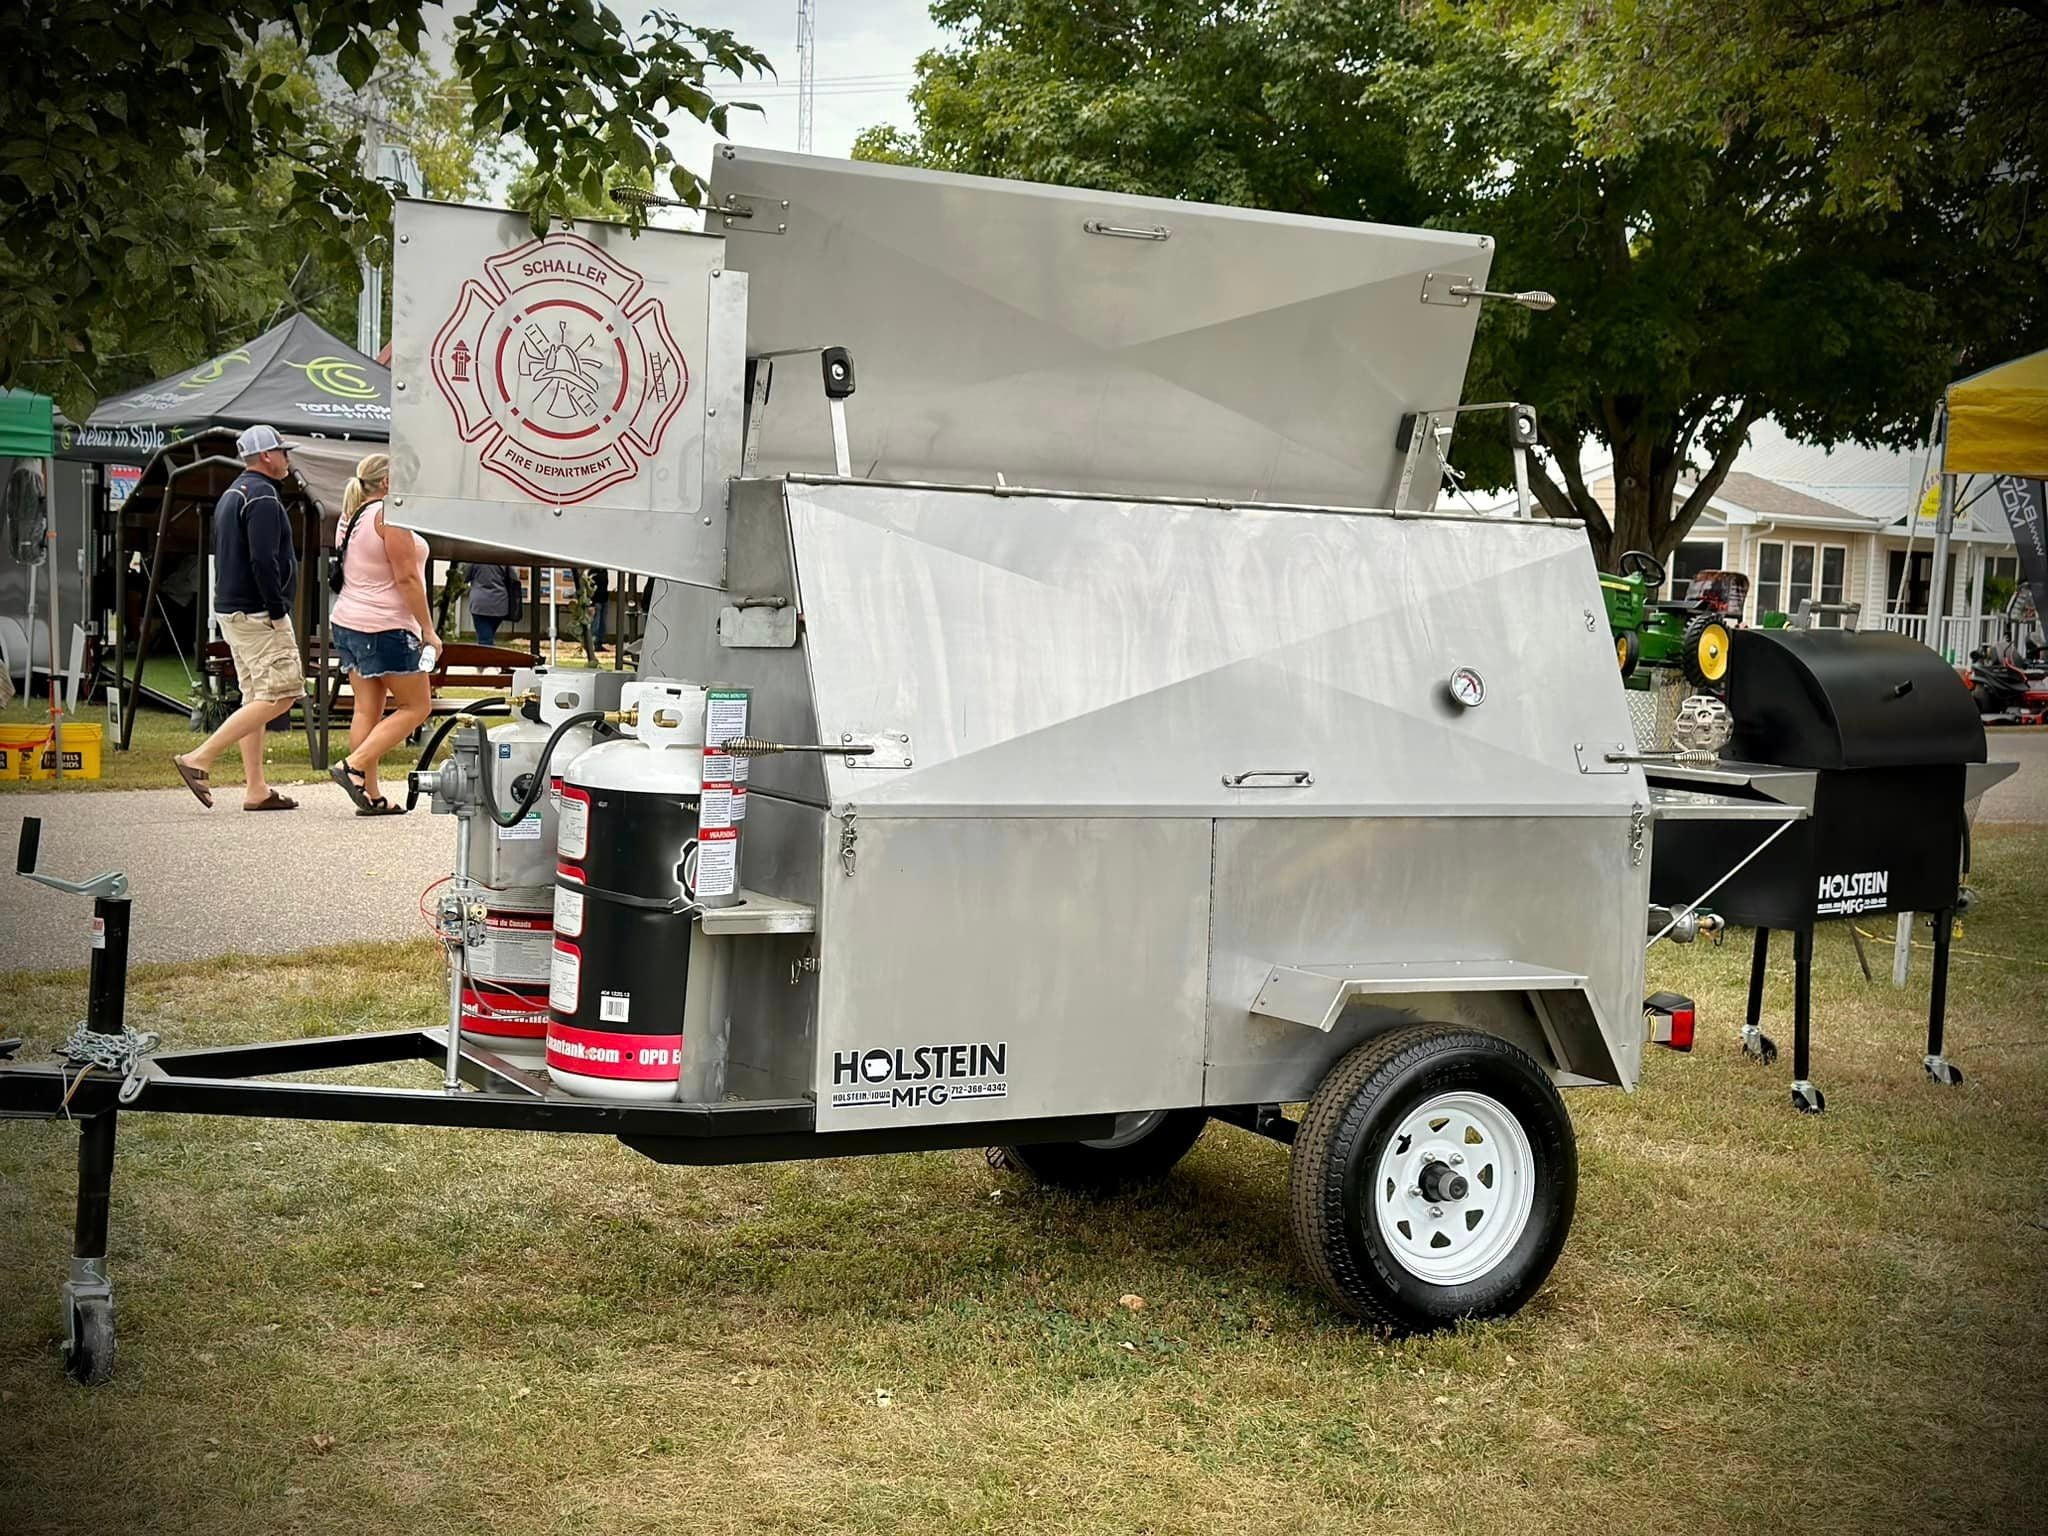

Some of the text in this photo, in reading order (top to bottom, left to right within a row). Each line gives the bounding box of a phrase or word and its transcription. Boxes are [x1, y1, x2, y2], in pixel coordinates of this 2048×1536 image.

[522, 259, 608, 286] SCHALLER
[76, 422, 168, 454] Relax in Style
[505, 448, 613, 478] FIRE DEPARTMENT
[709, 830, 736, 839] WARNING
[1818, 871, 1888, 899] HOLSTEIN
[1840, 898, 1864, 914] MFG
[639, 1048, 670, 1066] OPD
[833, 1043, 1006, 1084] HOLSTEIN
[871, 1090, 890, 1100] IOWA
[891, 1085, 949, 1108] MFG
